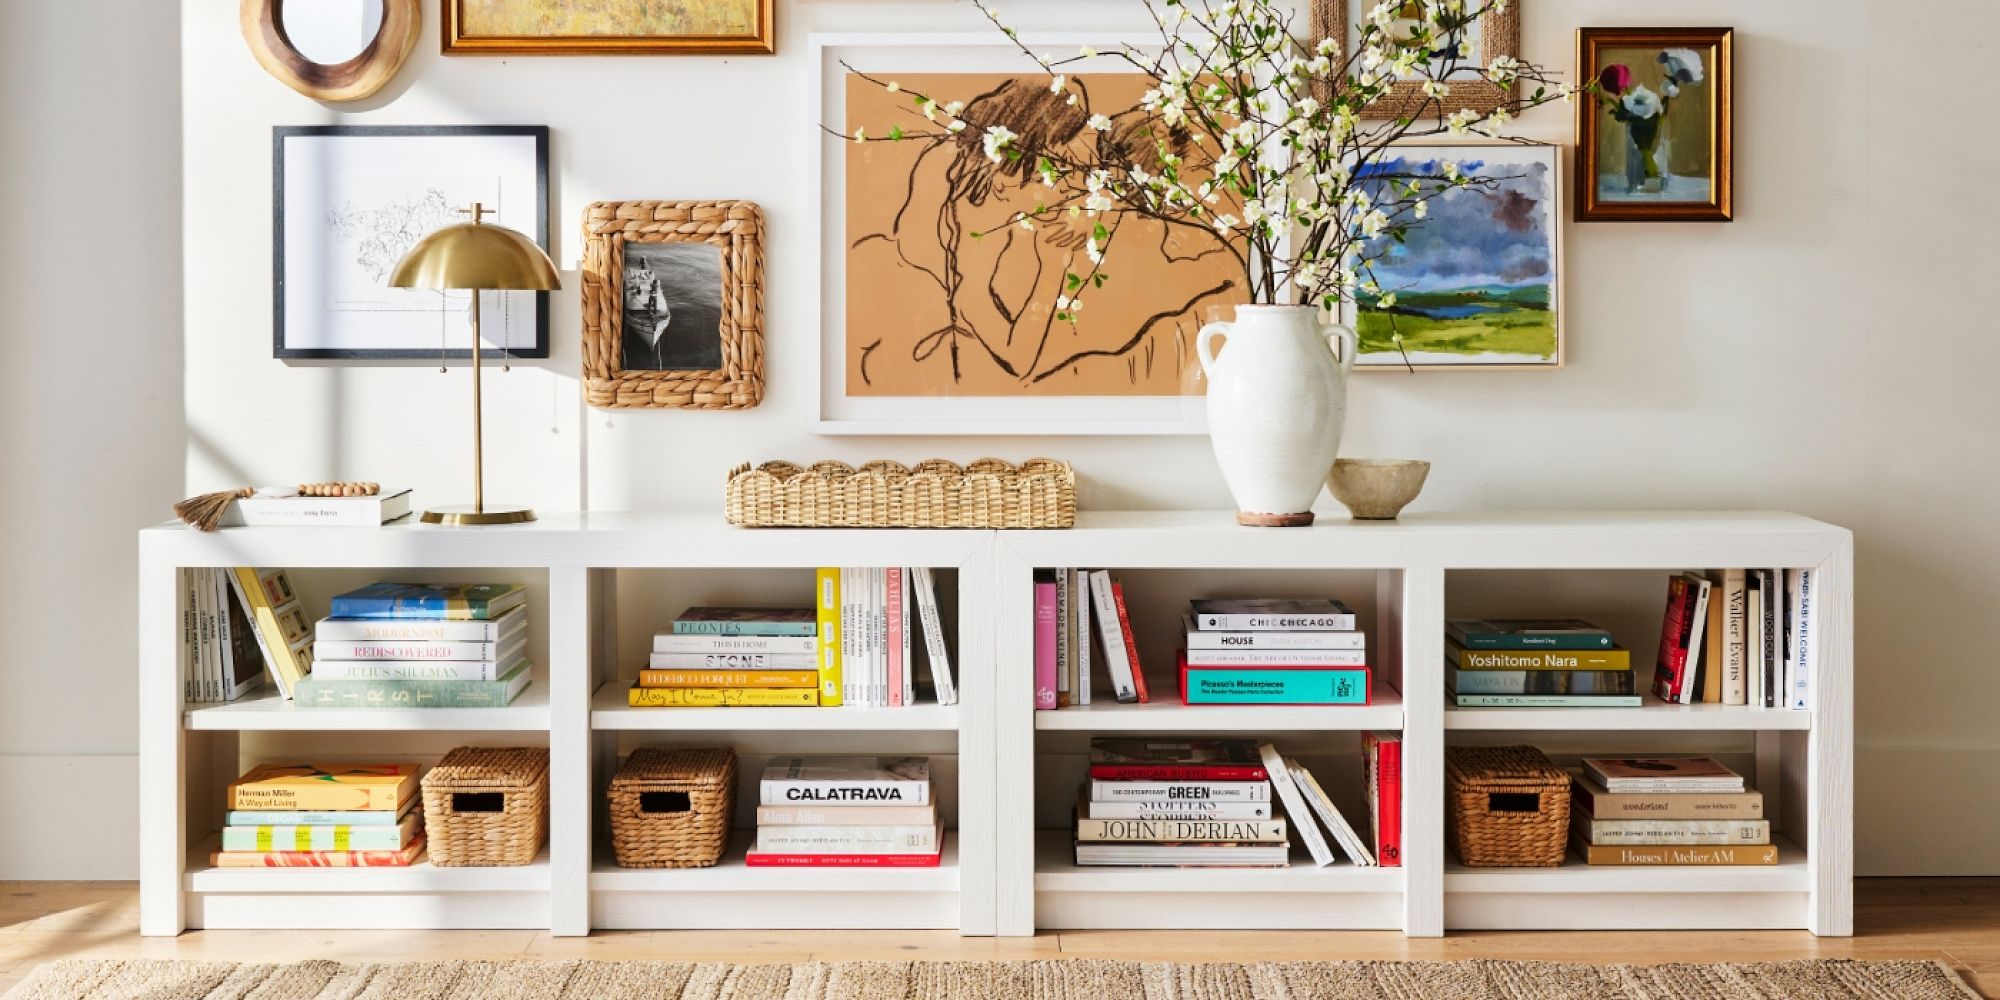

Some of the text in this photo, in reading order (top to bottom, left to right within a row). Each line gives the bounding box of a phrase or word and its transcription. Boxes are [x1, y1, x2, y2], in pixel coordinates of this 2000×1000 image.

[889, 569, 900, 633] DAHLIAS
[680, 622, 742, 633] PEONIES
[1280, 617, 1334, 627] CHICAGO
[366, 626, 445, 639] MODERNISM
[1729, 589, 1742, 681] Walker Evans
[1221, 636, 1254, 645] HOUSE
[1799, 620, 1808, 667] WELCOME
[354, 646, 452, 658] REDISCOVERED
[705, 655, 764, 668] STONE
[1468, 654, 1578, 667] Yoshitomo Nara
[346, 666, 459, 678] JULIUS SHULMAN
[238, 788, 295, 798] Herman Miller
[785, 787, 903, 801] CALATRAVA
[1168, 786, 1211, 799] GREEN
[245, 800, 263, 809] Way
[264, 799, 272, 807] of
[273, 799, 297, 809] Living
[1099, 821, 1260, 840] JOHN DERIAN
[1621, 850, 1734, 864] Houses Atelier AM
